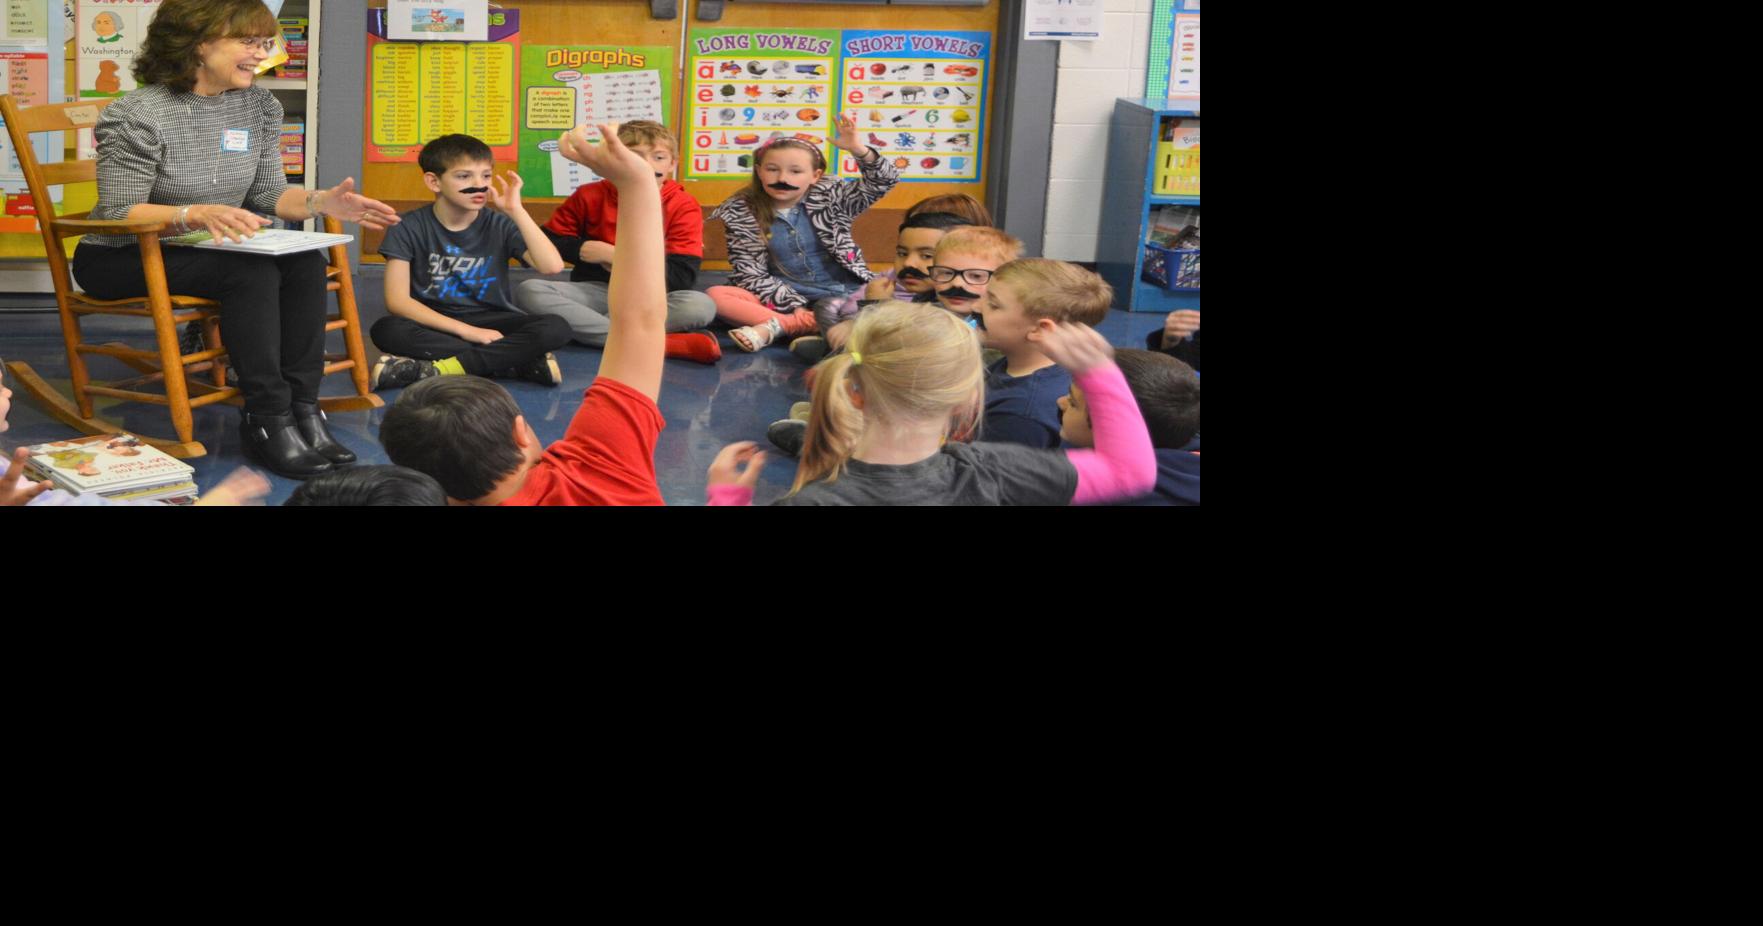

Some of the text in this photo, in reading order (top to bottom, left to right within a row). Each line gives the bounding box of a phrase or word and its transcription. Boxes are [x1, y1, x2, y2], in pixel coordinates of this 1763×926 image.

[82, 46, 134, 57] Washington
[697, 34, 832, 55] LONG VOWELS
[847, 36, 982, 57] SHORT VOWELS
[546, 48, 645, 68] Digraphs
[743, 107, 756, 122] 9
[925, 109, 939, 123] 6
